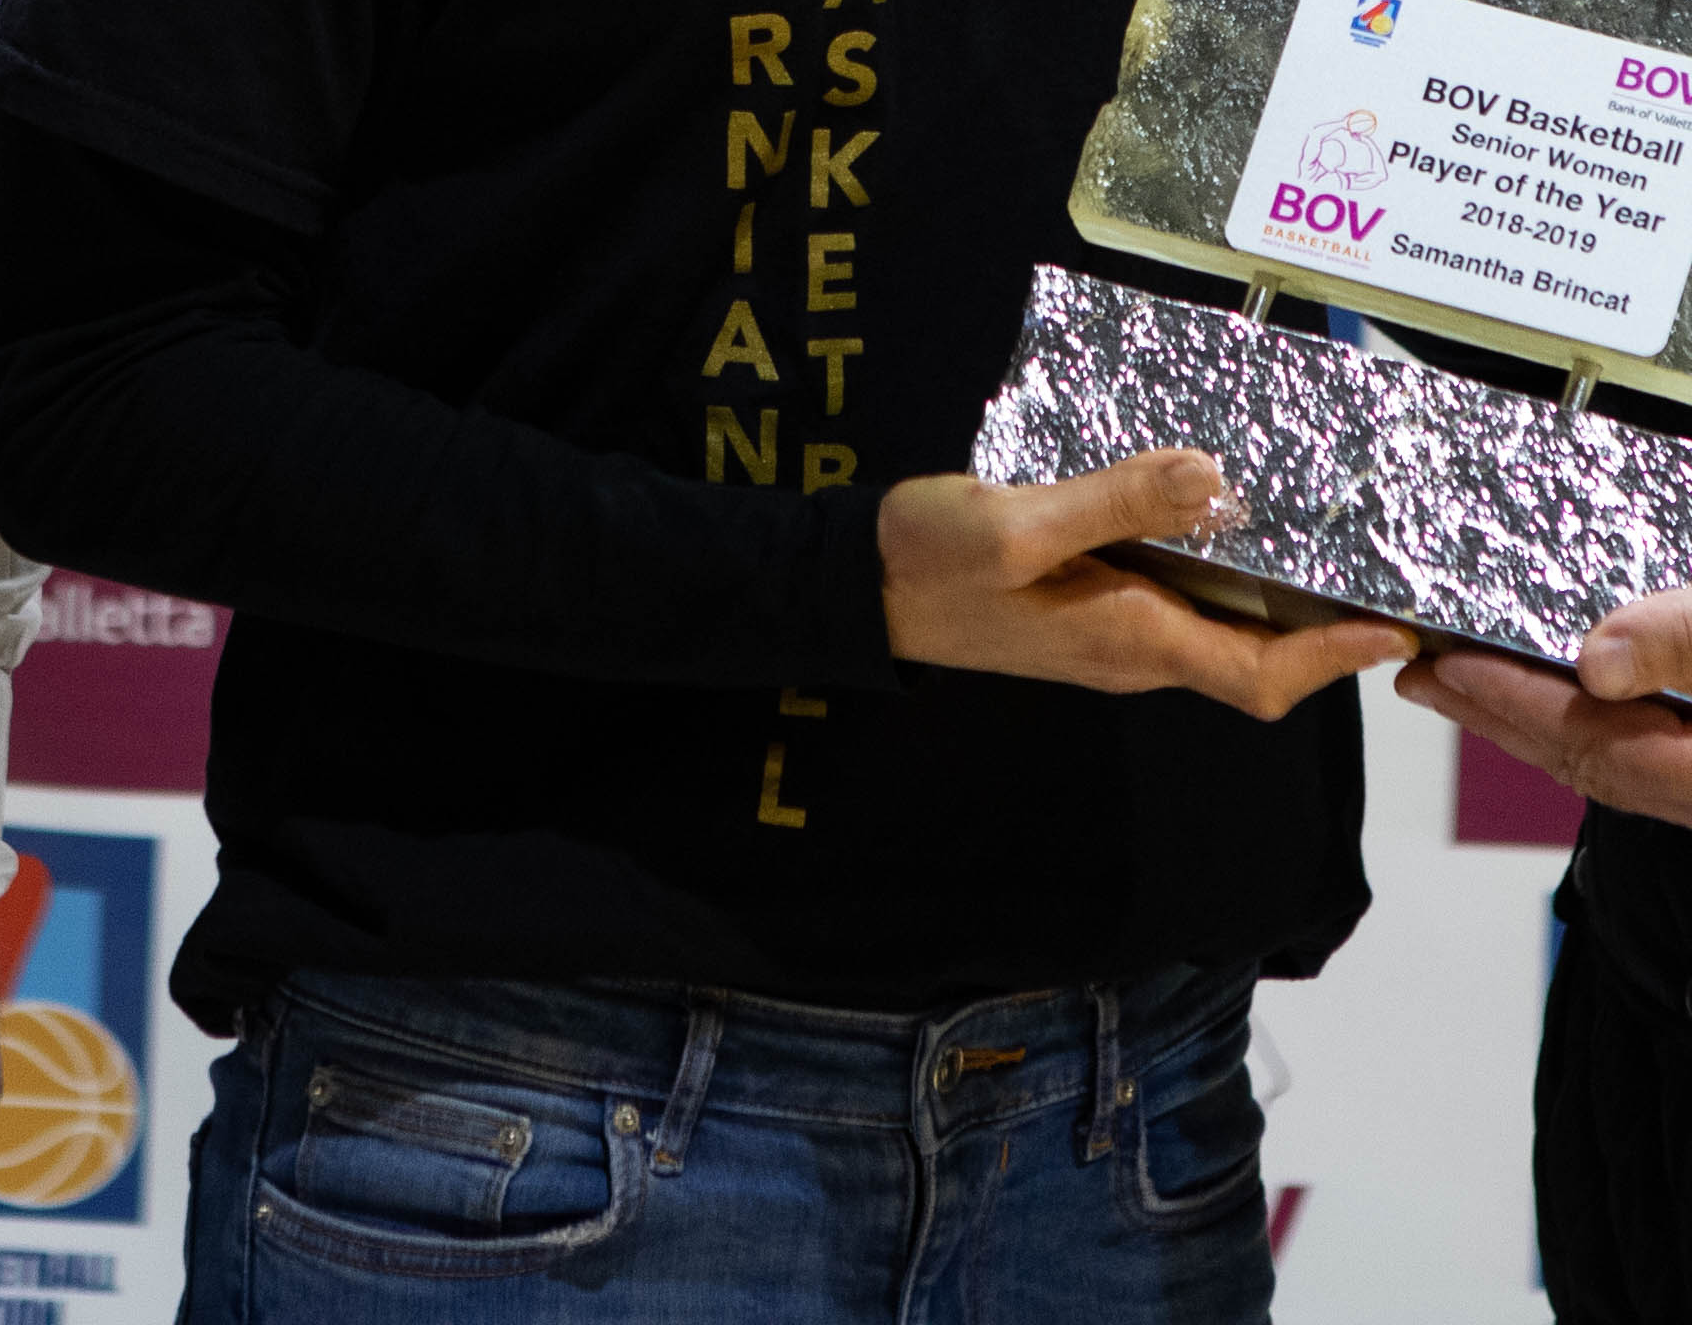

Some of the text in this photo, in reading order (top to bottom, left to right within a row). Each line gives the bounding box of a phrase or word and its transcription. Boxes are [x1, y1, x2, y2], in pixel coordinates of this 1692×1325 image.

[1422, 77, 1684, 166] BOV Basketball
[1607, 100, 1637, 118] Bank
[1638, 110, 1652, 120] of
[1388, 140, 1666, 233] Player of the Year
[1451, 123, 1648, 191] Senior Women
[1263, 223, 1372, 262] BASKETBALL
[1268, 182, 1387, 242] BOV
[1460, 202, 1597, 254] 2018-2019
[1390, 233, 1525, 287] Samantha
[1532, 270, 1632, 315] Brincat
[41, 581, 217, 651] alletta
